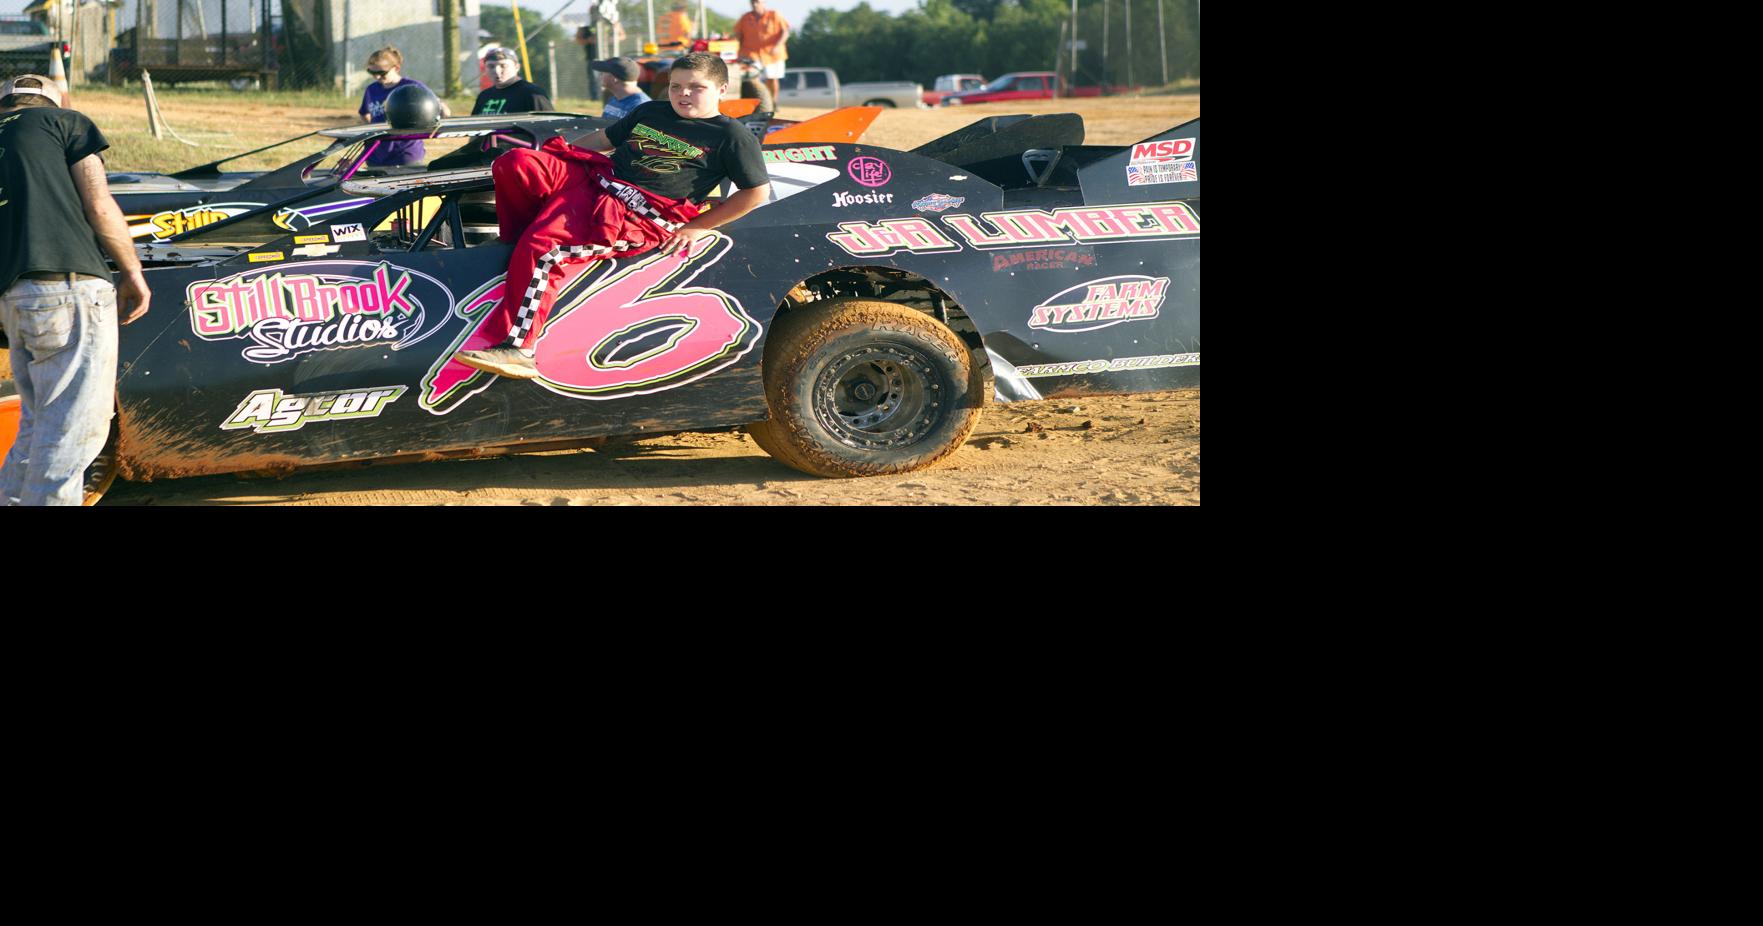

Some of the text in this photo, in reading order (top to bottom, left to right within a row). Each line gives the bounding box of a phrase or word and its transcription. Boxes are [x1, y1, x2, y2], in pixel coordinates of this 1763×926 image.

[1133, 140, 1192, 159] MSD
[832, 190, 894, 207] Hoosier
[333, 224, 360, 236] WIX
[942, 203, 1200, 247] LUMBER
[993, 249, 1095, 272] AMERICAN
[1026, 261, 1064, 270] RACER
[1085, 278, 1169, 300] FARM
[1031, 299, 1161, 327] SYSTEMS
[244, 313, 400, 362] Studios
[1109, 353, 1200, 371] BUILDER
